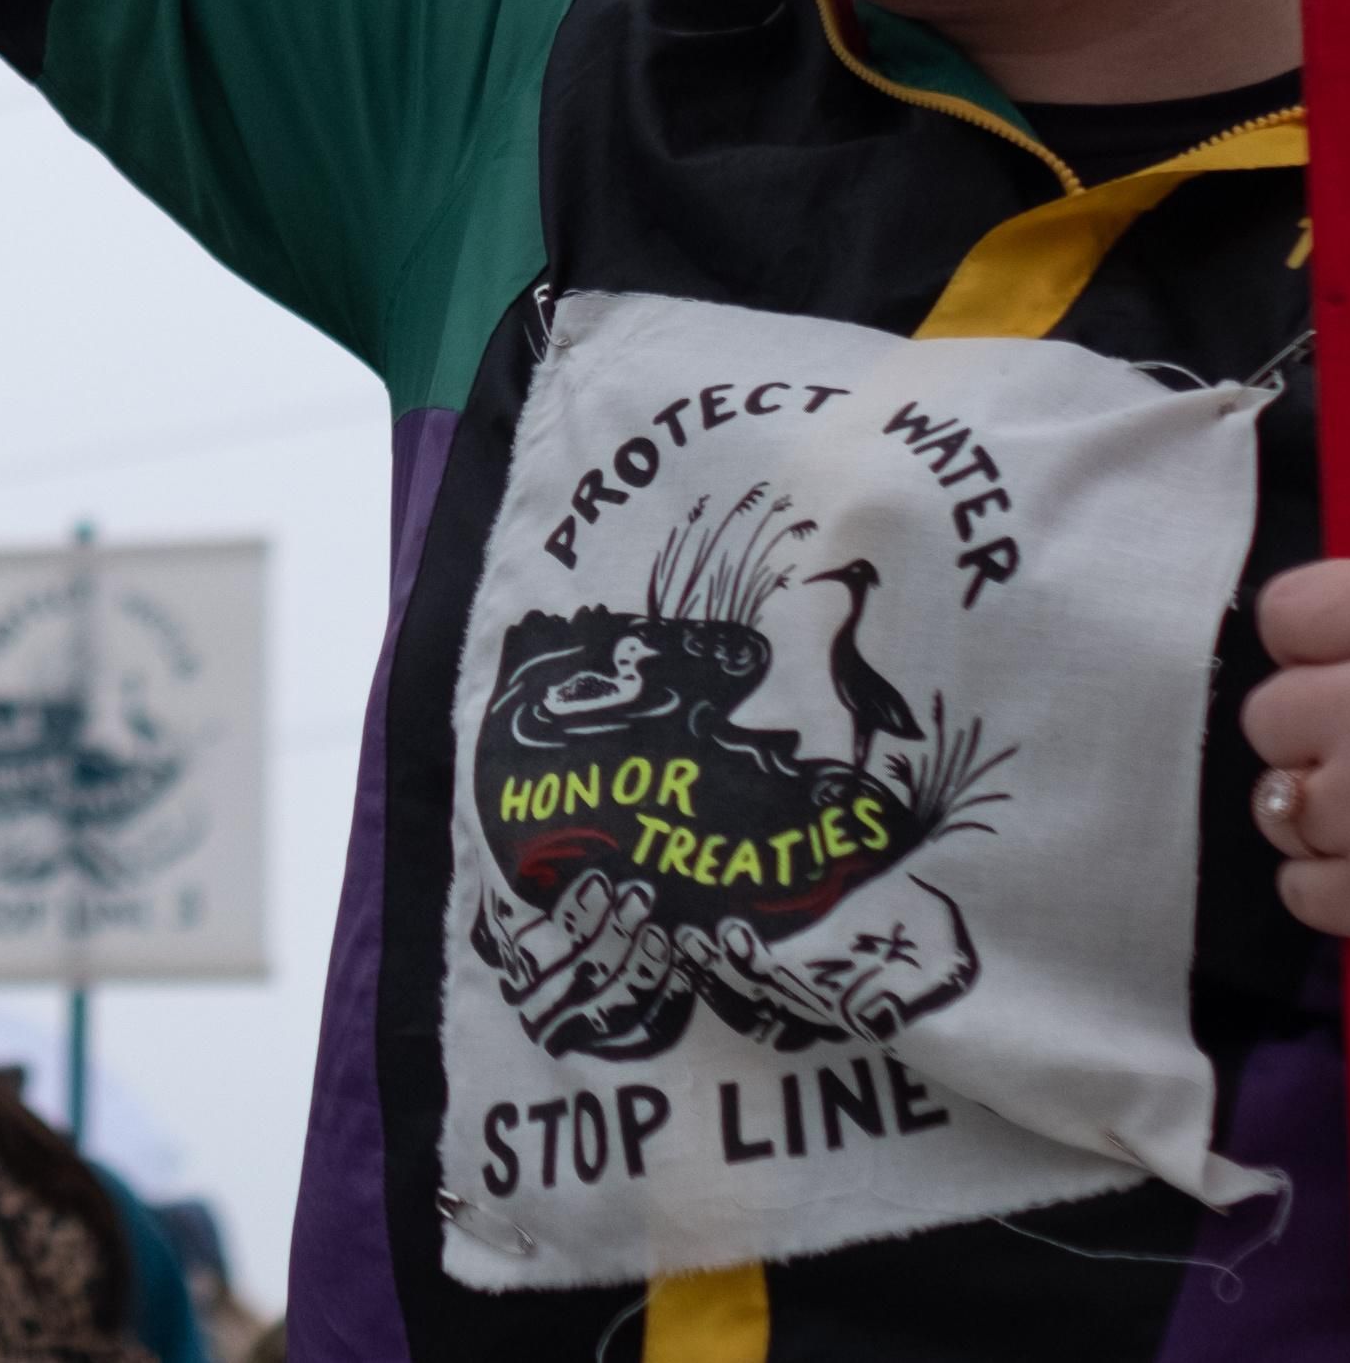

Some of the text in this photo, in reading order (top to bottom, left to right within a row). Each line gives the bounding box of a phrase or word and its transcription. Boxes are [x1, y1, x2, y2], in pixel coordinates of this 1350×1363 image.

[544, 381, 1021, 609] PROTECT WATER
[499, 756, 700, 824] HONOR
[631, 797, 890, 887] TREATIES
[481, 1055, 951, 1198] STOP LINE
